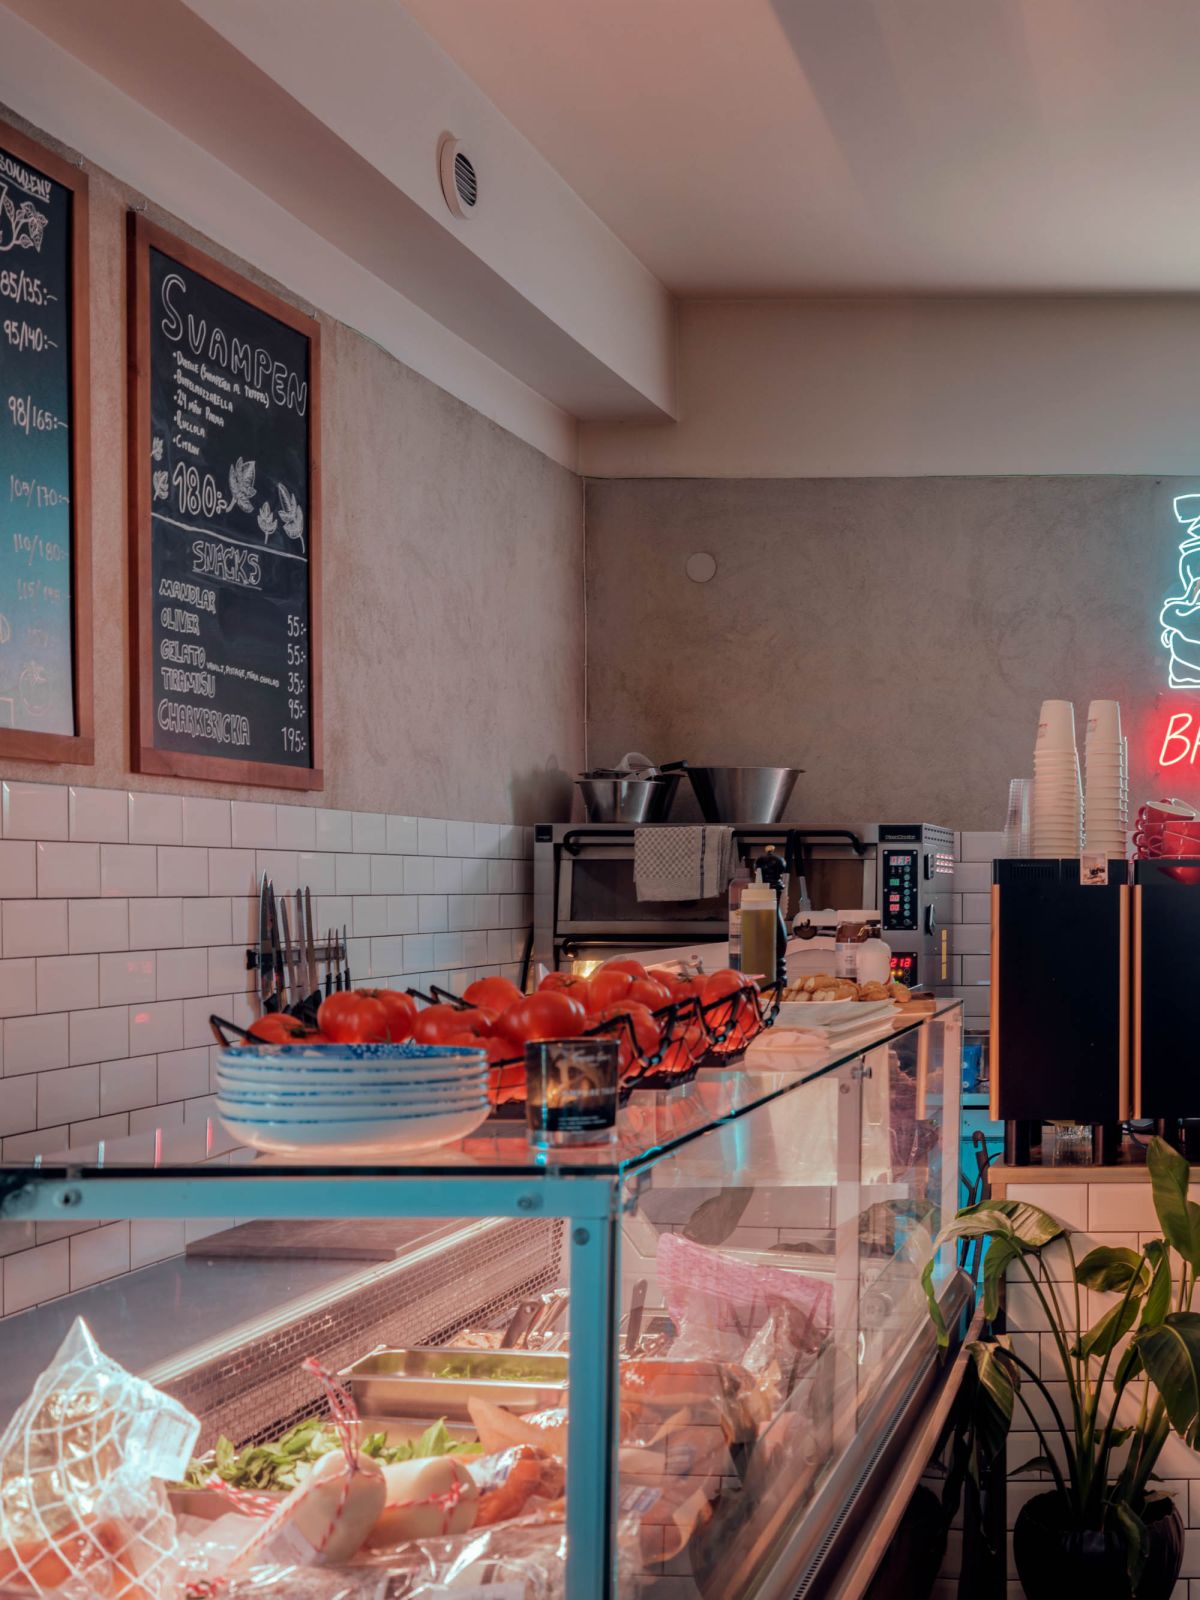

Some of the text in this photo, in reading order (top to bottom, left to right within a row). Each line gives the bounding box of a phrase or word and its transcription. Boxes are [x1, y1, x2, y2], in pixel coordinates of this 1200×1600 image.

[161, 273, 307, 417] SVAMPEN
[192, 540, 262, 585] SNACKS
[159, 578, 217, 614] MANDLAR
[160, 607, 200, 636] OLIVER
[160, 638, 206, 669] GELATO
[161, 666, 216, 699] TIRAMISU
[157, 698, 250, 746] CHARKBRICKA
